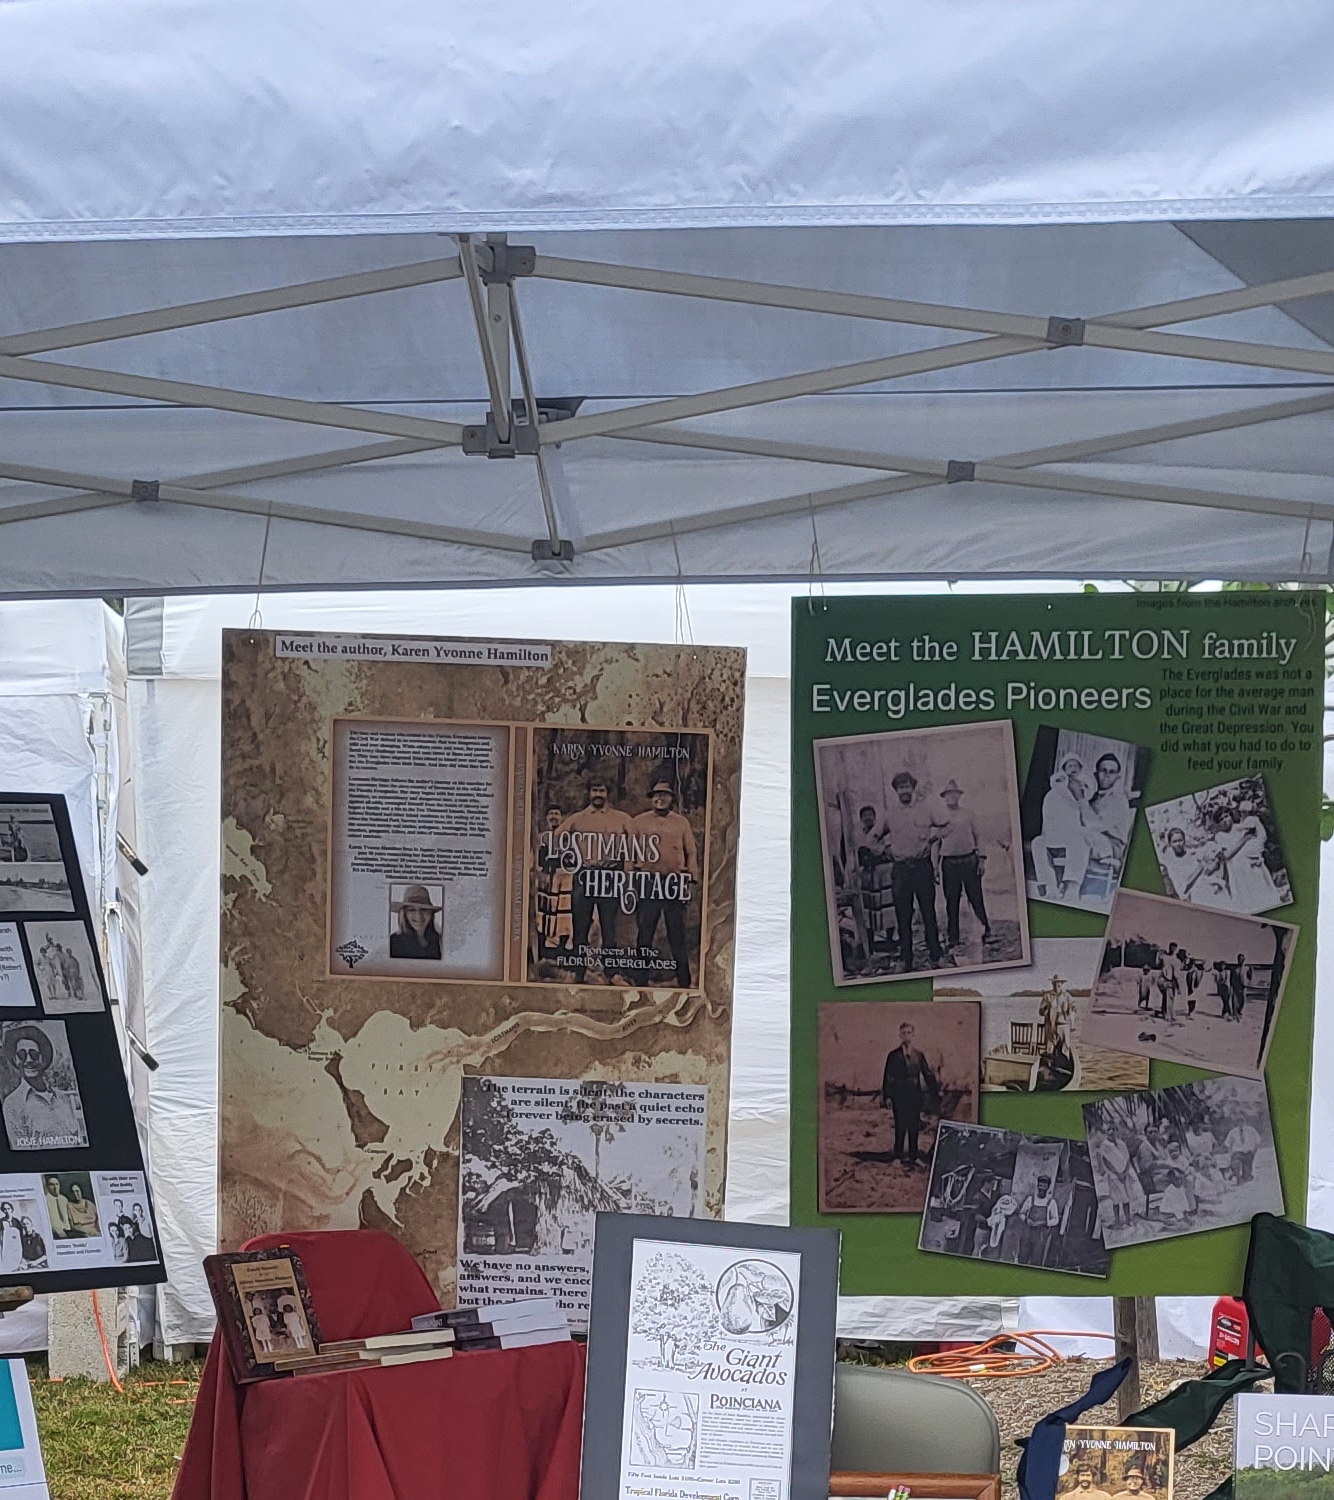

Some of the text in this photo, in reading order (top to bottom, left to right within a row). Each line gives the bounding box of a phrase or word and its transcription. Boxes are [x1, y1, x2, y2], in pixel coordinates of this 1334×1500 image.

[280, 640, 549, 662] Meet the author, Karen Yvonne Hamilton
[825, 629, 1298, 665] Meet the HAMILTON family
[1161, 668, 1312, 683] The Everglades was not a
[812, 681, 1151, 719] Everglades Pioneers
[1160, 686, 1314, 701] place for the average man
[1166, 704, 1306, 718] during the Civil War and
[1160, 722, 1314, 736] the Great Depression. You
[1161, 739, 1311, 755] did what you had to do to
[1188, 757, 1286, 772] feed your family.
[542, 831, 660, 873] LOSTMANS
[579, 870, 692, 914] HERITAGE
[555, 956, 677, 970] FLORIDA EVERGLADES
[703, 1340, 783, 1368] The Giant
[688, 1362, 787, 1385] Avocados
[710, 1394, 782, 1410] POINCIANA
